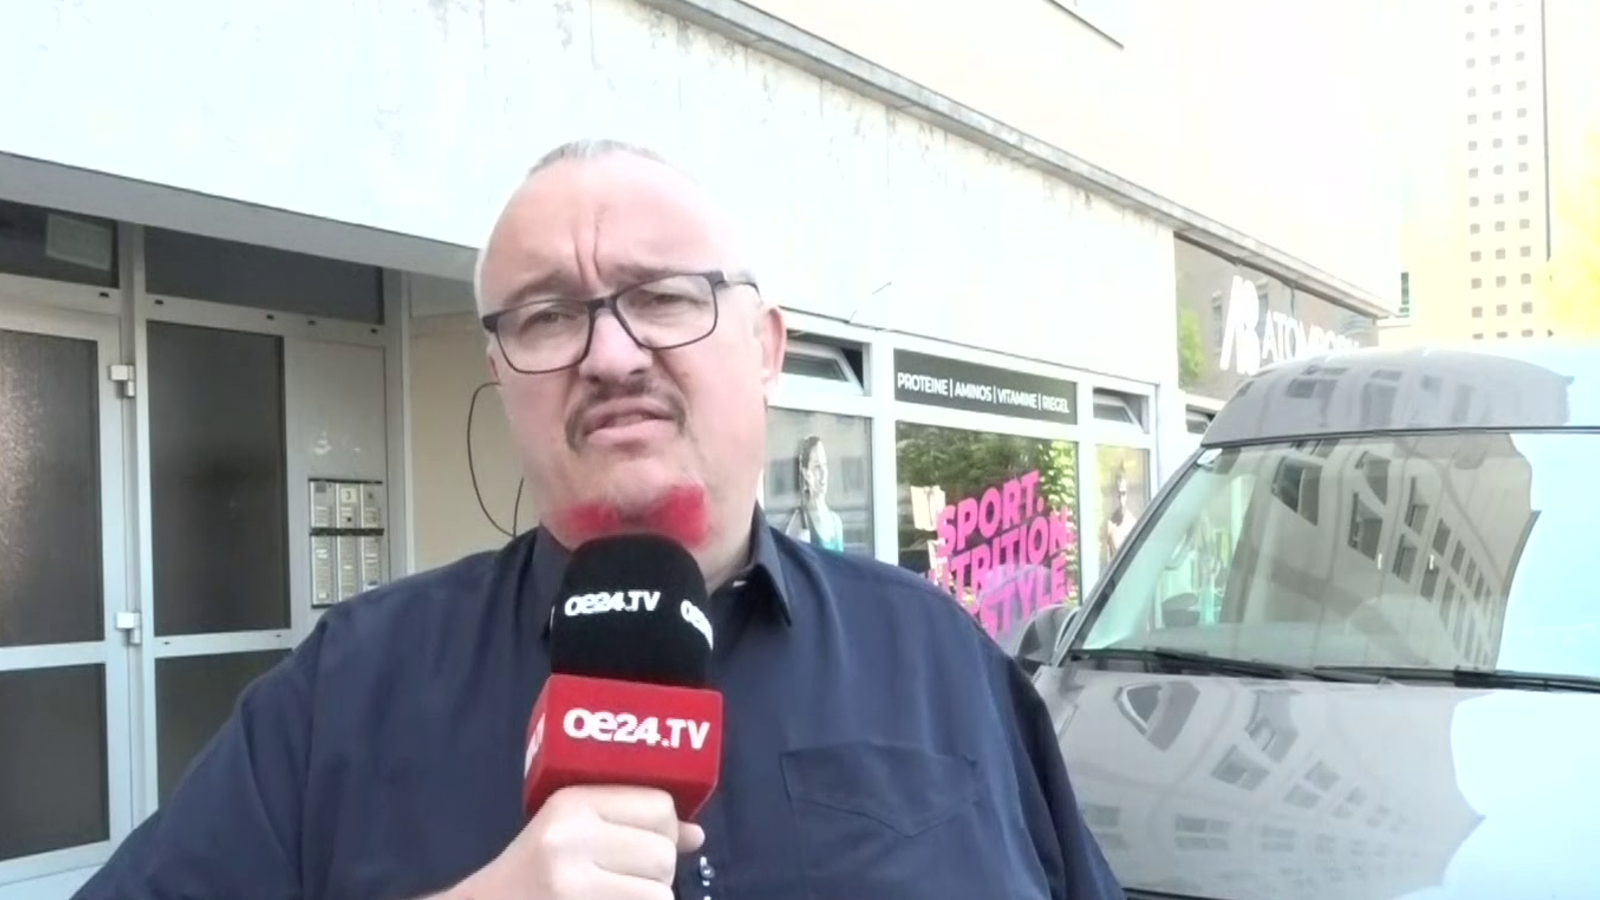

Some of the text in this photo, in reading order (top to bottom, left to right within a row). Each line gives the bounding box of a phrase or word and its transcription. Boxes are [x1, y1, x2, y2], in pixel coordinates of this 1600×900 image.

[897, 372, 1070, 414] PROTEINE AMINOS VITAMINE RIEGEL
[937, 470, 1044, 552] SPORT.
